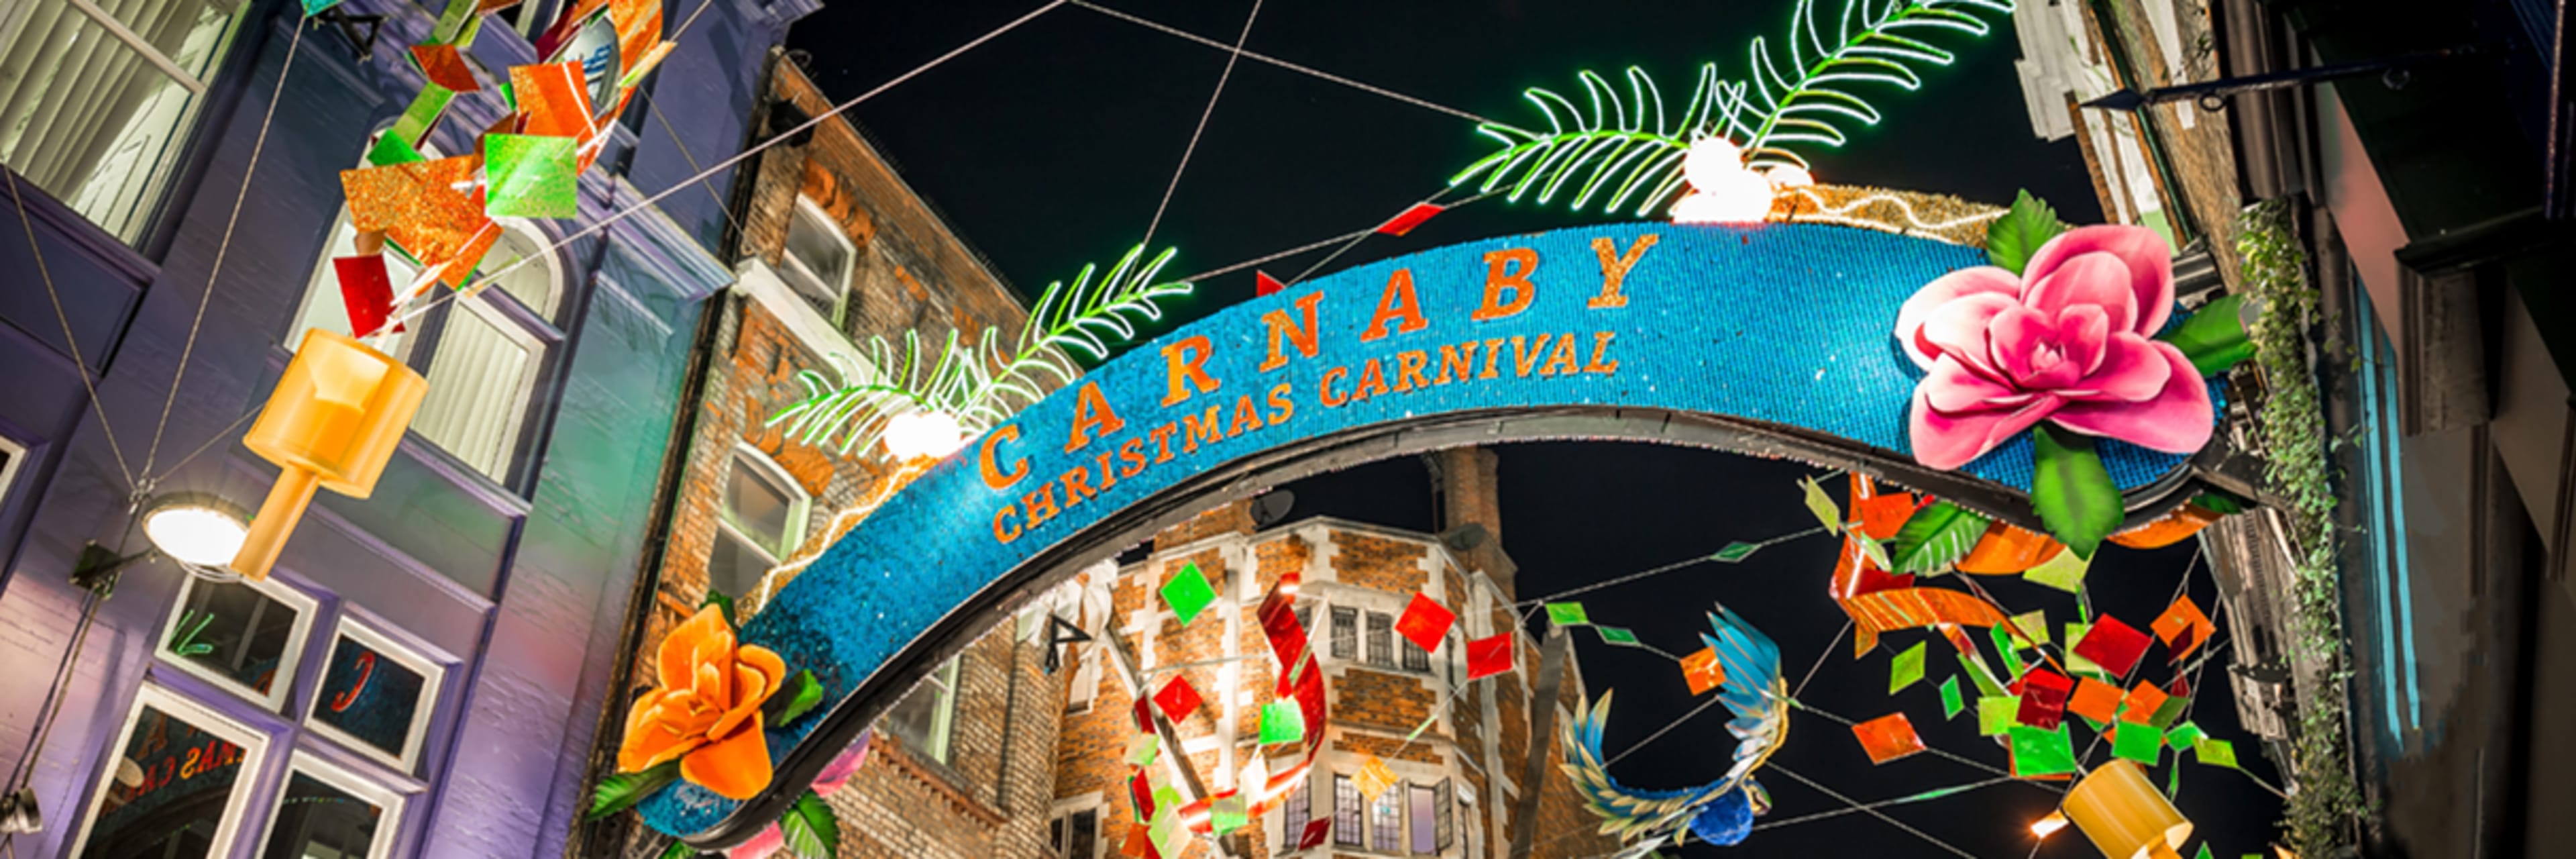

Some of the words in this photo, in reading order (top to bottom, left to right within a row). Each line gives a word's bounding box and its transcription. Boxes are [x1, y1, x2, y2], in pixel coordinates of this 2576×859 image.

[979, 234, 1658, 490] CARNABY
[993, 383, 1294, 544] CHRISTMAS
[1320, 332, 1619, 407] CARNIVAL
